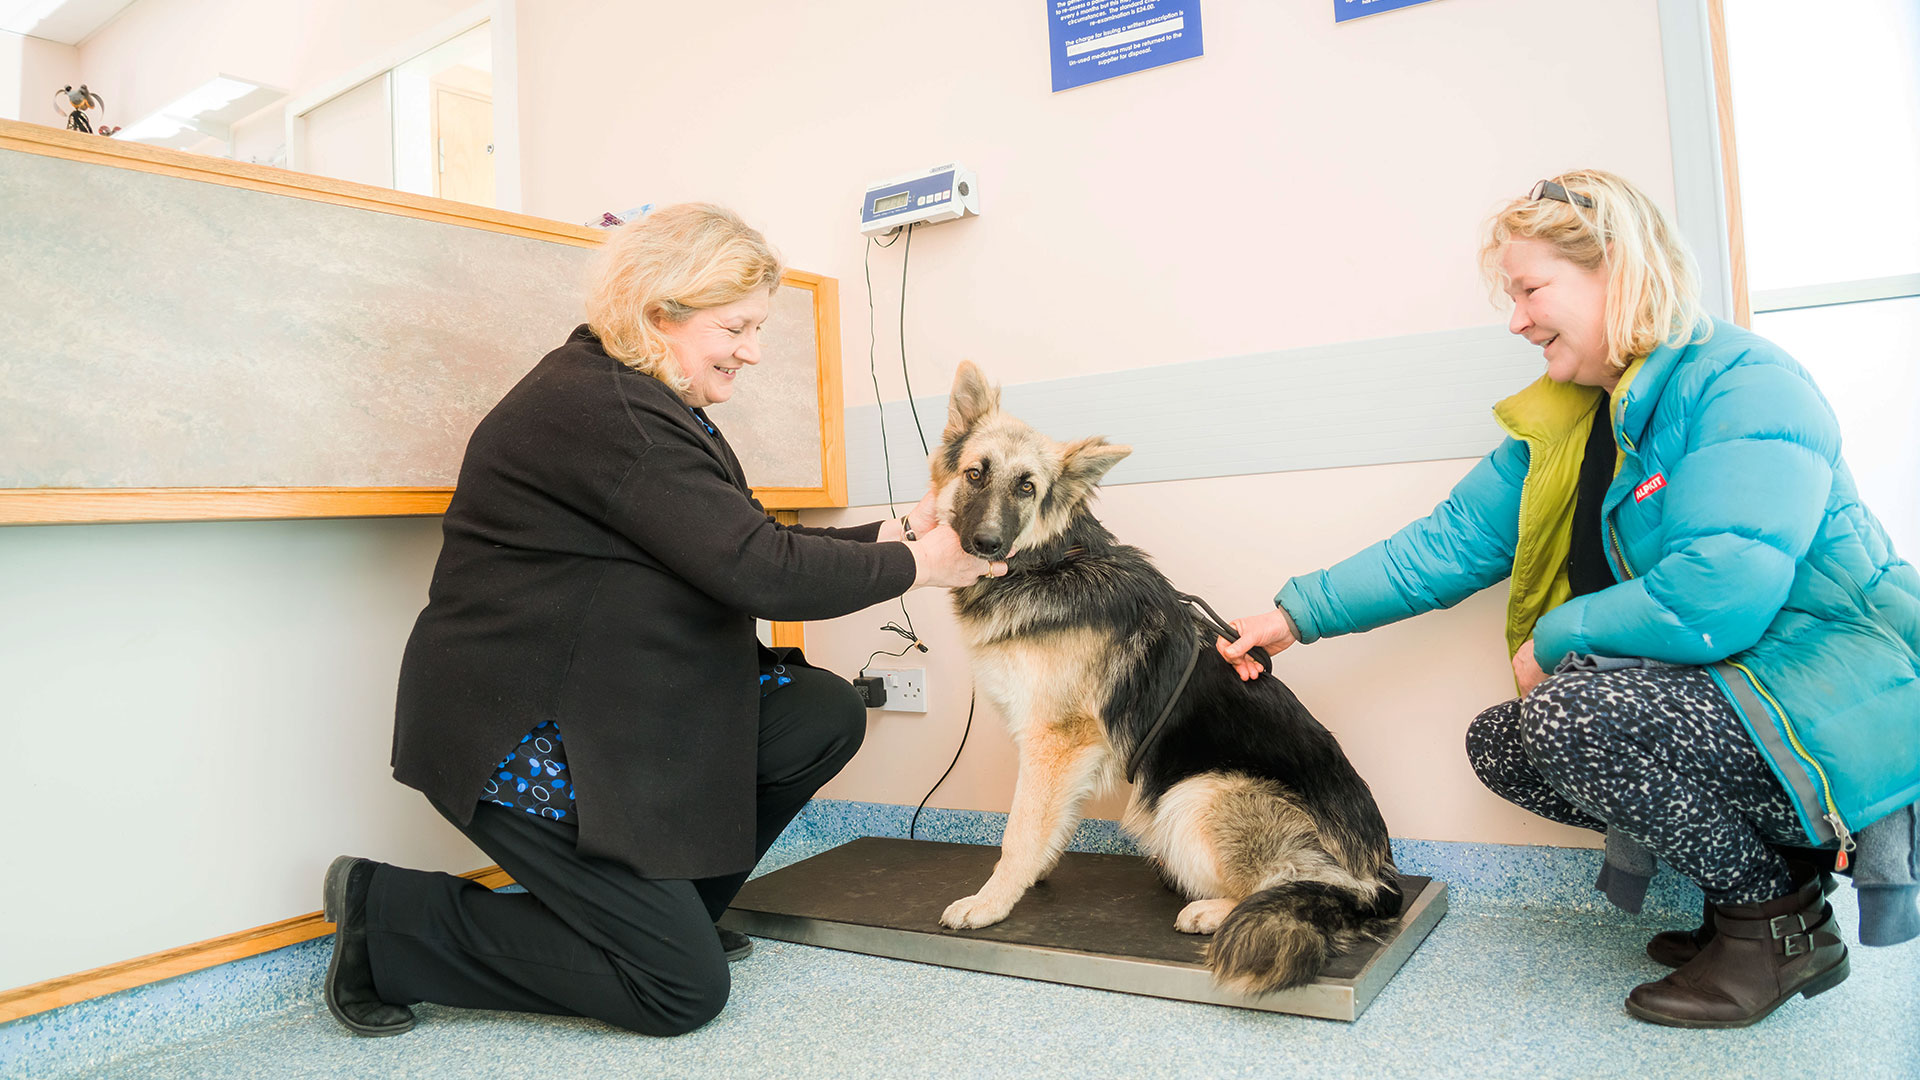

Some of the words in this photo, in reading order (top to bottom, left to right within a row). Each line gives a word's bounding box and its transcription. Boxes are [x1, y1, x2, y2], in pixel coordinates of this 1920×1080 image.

[1119, 0, 1144, 11] standard
[1060, 12, 1075, 21] every
[1080, 6, 1099, 15] months
[1089, 11, 1131, 26] re-examination
[1075, 35, 1095, 43] charge
[1103, 27, 1121, 36] issuing
[1127, 21, 1145, 29] written
[1145, 12, 1179, 26] prescription
[1069, 56, 1091, 66] Un-used
[1091, 49, 1119, 60] medicines
[1120, 44, 1133, 53] must
[1142, 35, 1165, 47] returned
[1097, 56, 1119, 66] supplier
[1635, 476, 1662, 501] ALPKIT
